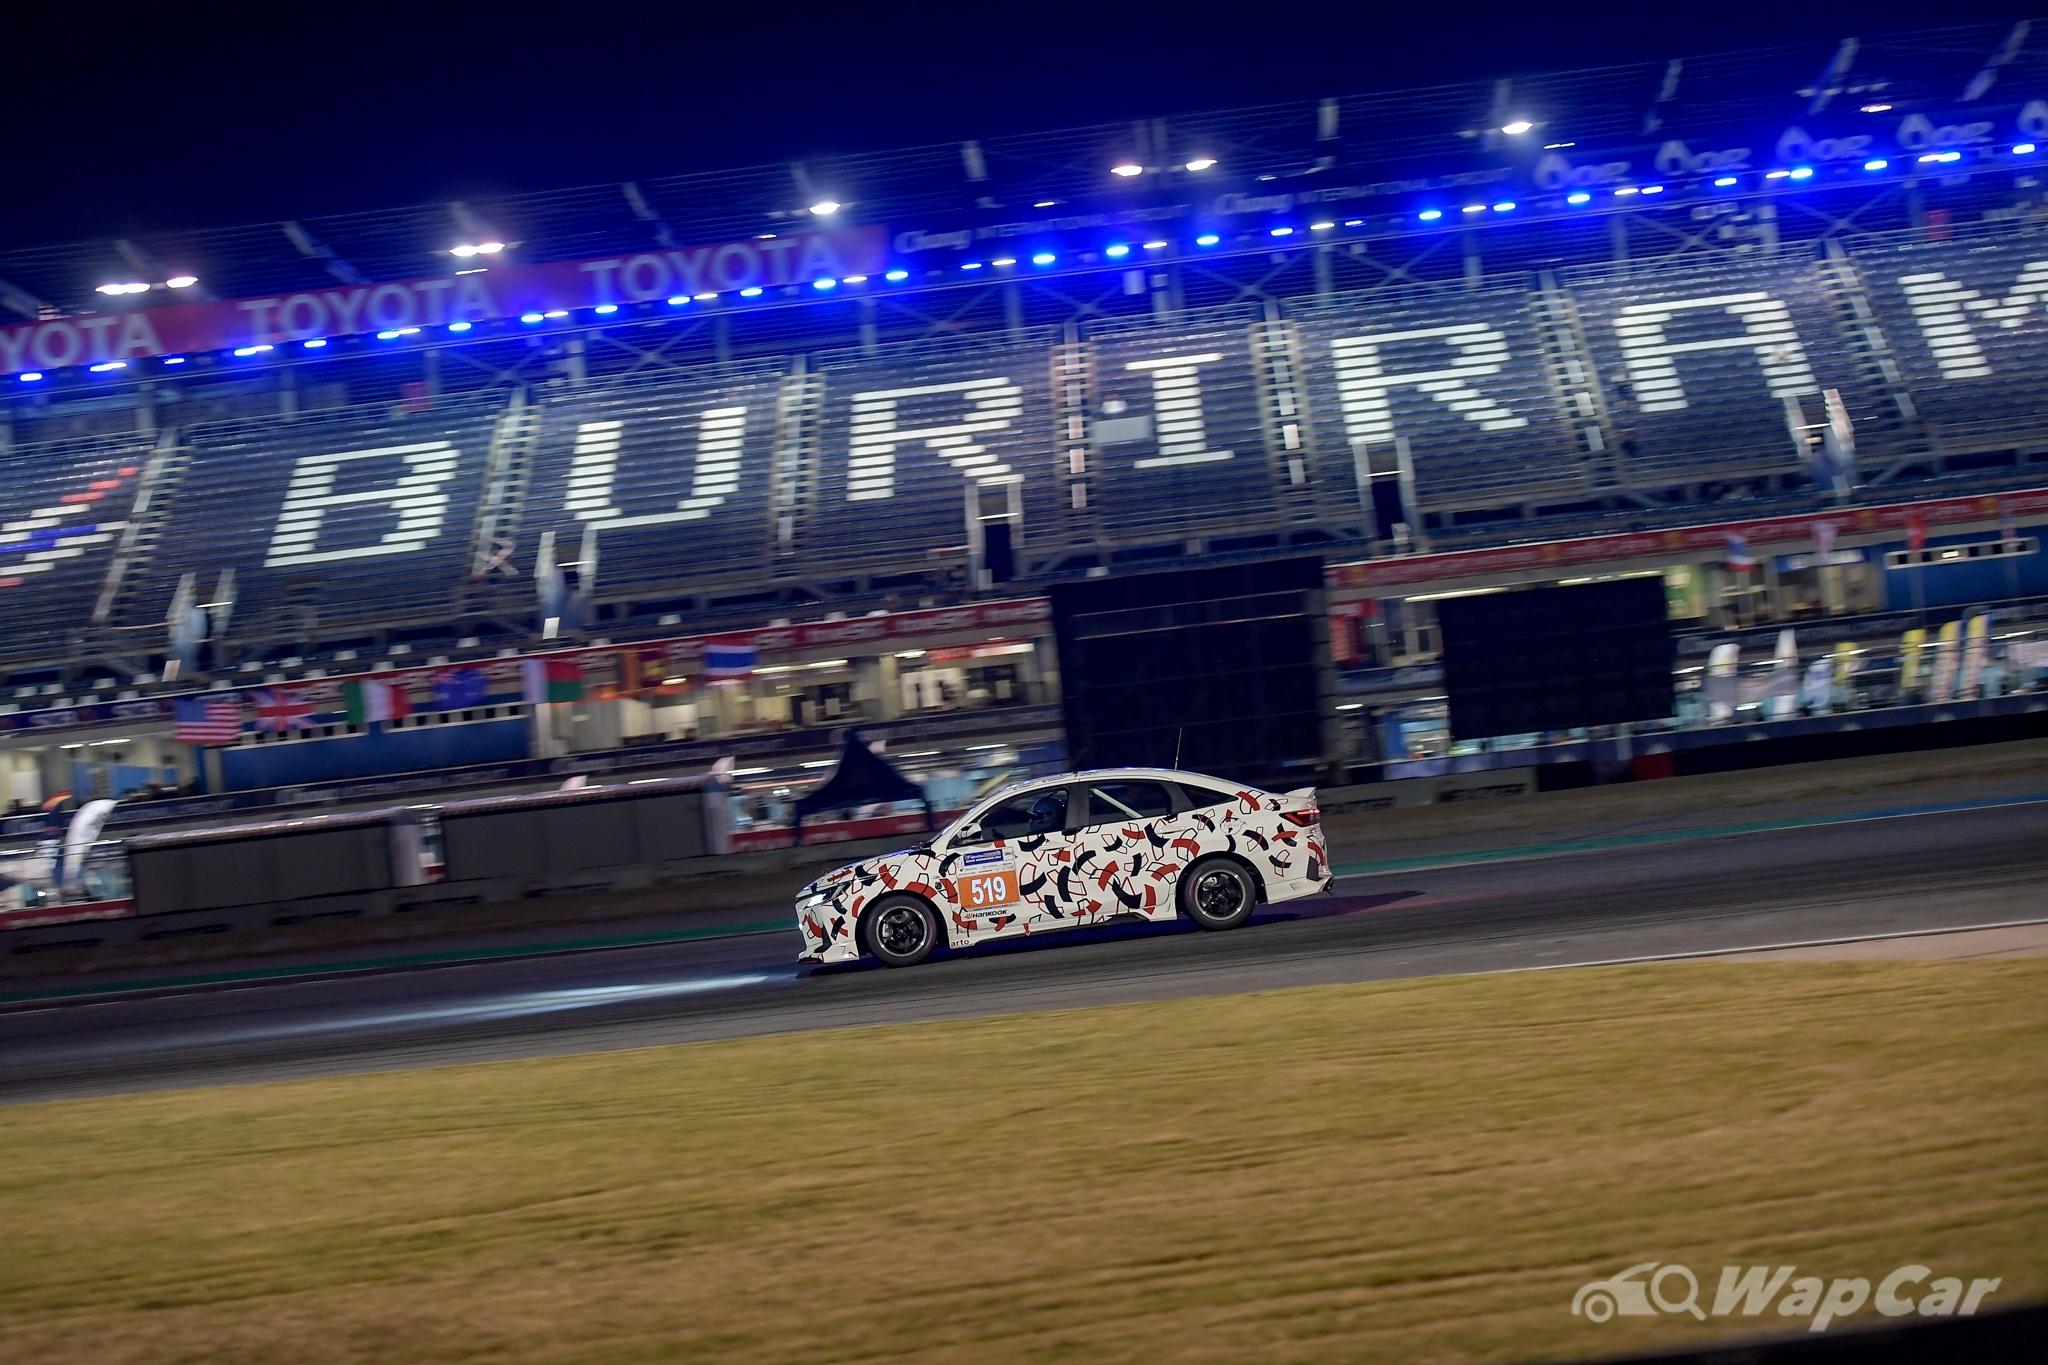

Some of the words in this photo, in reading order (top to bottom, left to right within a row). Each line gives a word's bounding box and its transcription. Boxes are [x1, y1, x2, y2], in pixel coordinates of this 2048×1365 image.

[579, 235, 840, 304] TOYOTA
[236, 276, 499, 345] TOYOTA
[971, 875, 1006, 905] 519
[950, 939, 970, 947] arto
